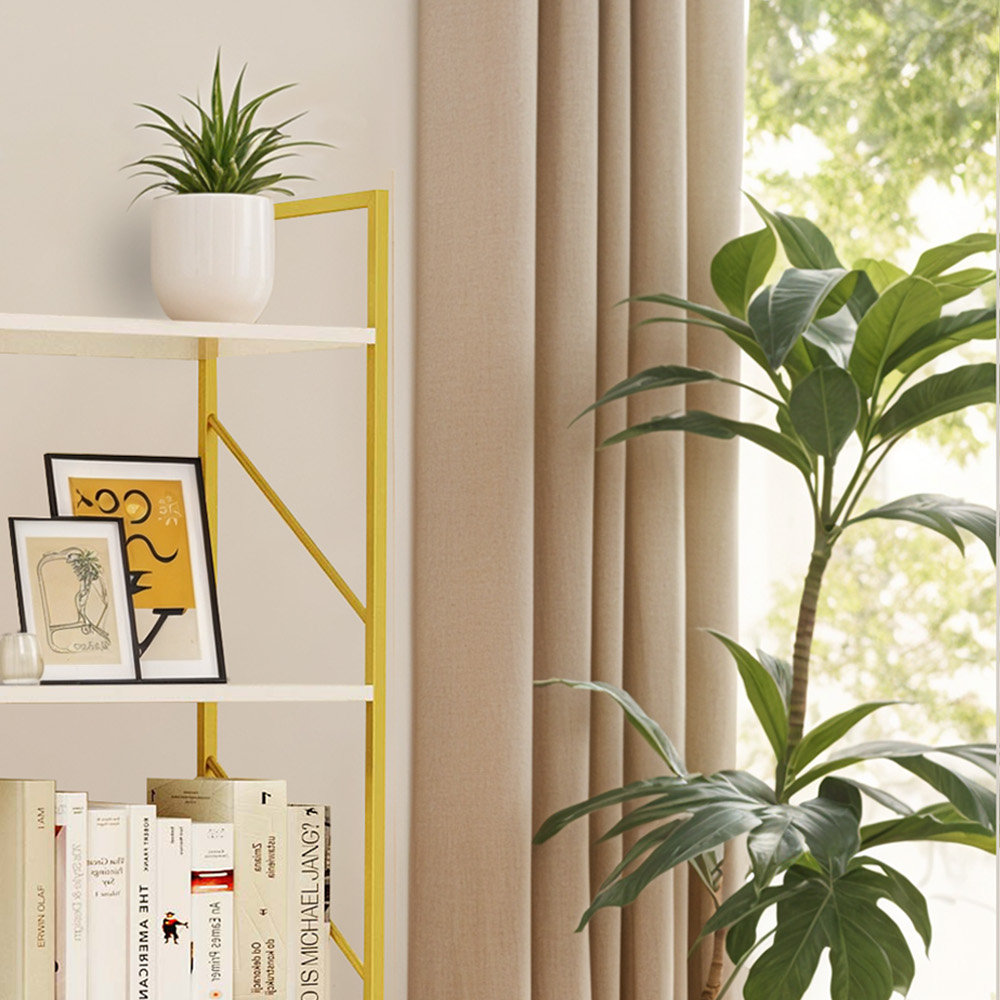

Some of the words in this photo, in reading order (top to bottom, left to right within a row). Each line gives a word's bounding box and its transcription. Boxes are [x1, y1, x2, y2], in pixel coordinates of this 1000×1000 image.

[37, 807, 45, 823] AM
[301, 823, 320, 881] JANG?
[37, 885, 46, 912] OLAF
[37, 914, 45, 948] ERWIN
[301, 883, 319, 966] MICHAEL
[300, 969, 319, 986] IS
